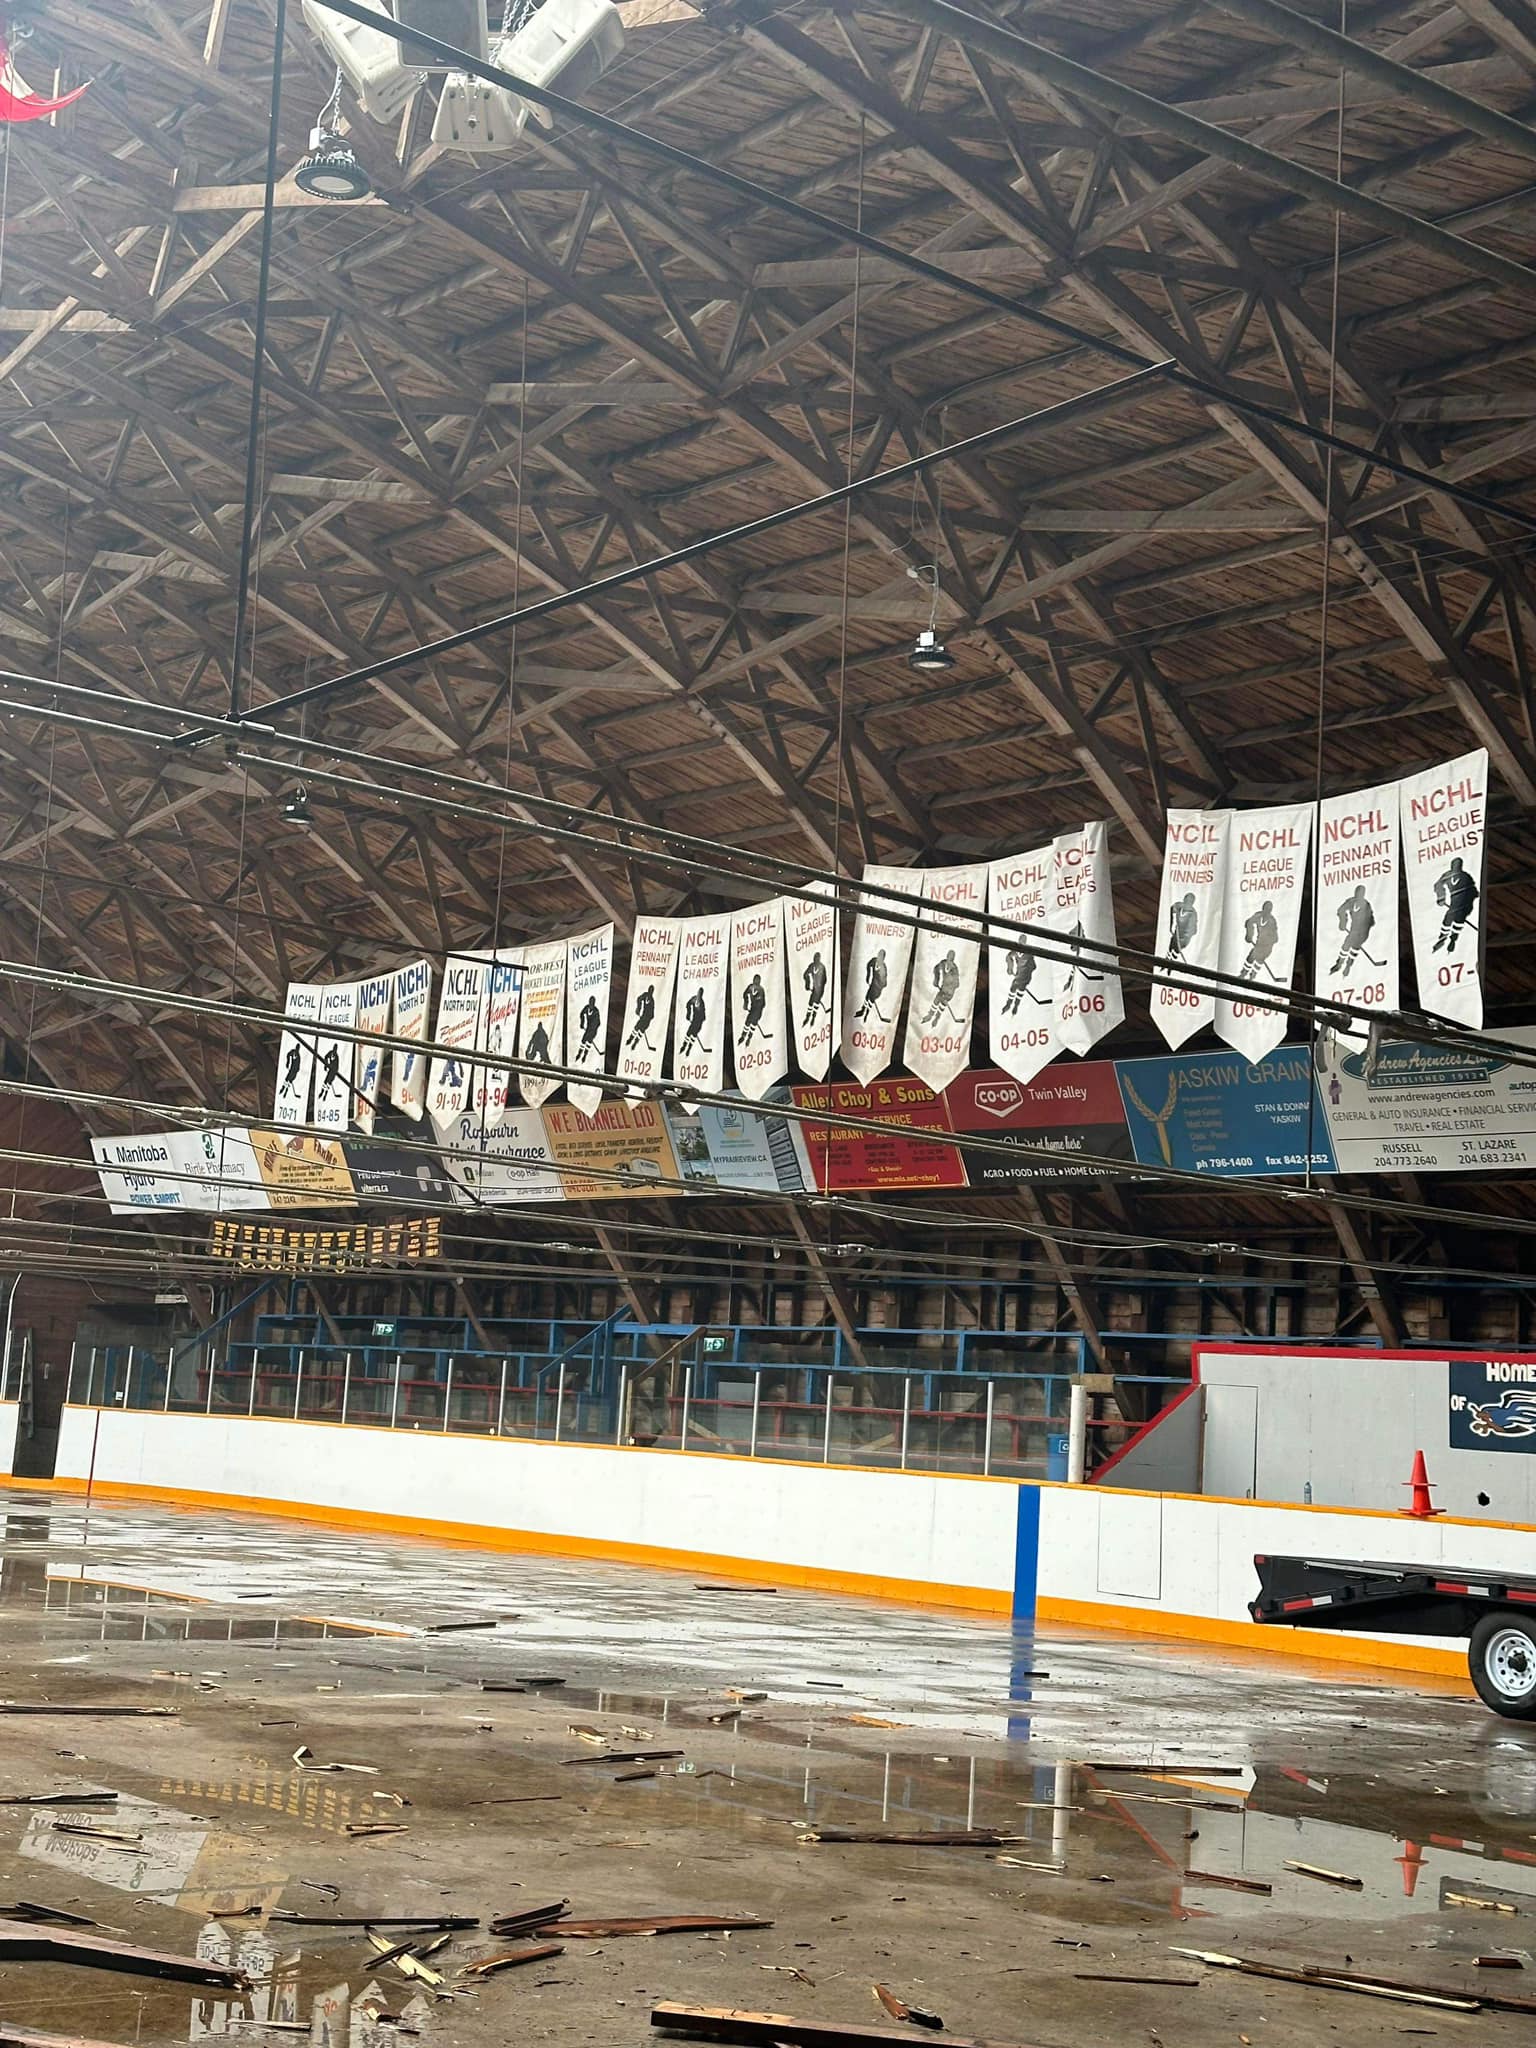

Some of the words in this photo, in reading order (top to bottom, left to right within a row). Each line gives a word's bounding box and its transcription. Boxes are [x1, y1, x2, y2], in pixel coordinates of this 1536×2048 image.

[1410, 778, 1484, 821] NCHL
[1324, 808, 1389, 844] NCHL
[1419, 809, 1482, 843] LEAGUE
[1240, 828, 1301, 852] NCHL
[1323, 839, 1392, 868] PENNANT
[1243, 858, 1294, 875] LEAGUE
[1323, 860, 1392, 887] WINNERS
[997, 863, 1047, 892] NCHL
[1240, 876, 1294, 892] CHAMPS
[930, 882, 978, 901] NCHL
[1000, 890, 1042, 912] LEAGUE
[736, 914, 776, 938] NCHL
[796, 912, 831, 937] LEAGUE
[866, 922, 905, 938] WINNERS
[639, 928, 674, 946] NCHL
[686, 929, 722, 948] NCHL
[795, 926, 833, 952] CHAMPS
[572, 938, 608, 961] NCHL
[736, 937, 776, 958] PENNANT
[636, 950, 672, 964] PENNANT
[685, 952, 719, 966] LEAGUE
[737, 952, 775, 971] WINNERS
[528, 959, 564, 976] OR-WEST
[574, 959, 608, 978] LEAGUE
[638, 965, 667, 977] WINNER
[683, 966, 720, 980] CHAMPS
[447, 969, 478, 996] NCHL
[483, 966, 521, 994] NCHL
[573, 972, 609, 992] CHAMPS
[290, 994, 316, 1009] NCHL
[325, 994, 352, 1009] NCHL
[443, 999, 466, 1011] NORTH
[1160, 987, 1200, 1008] 05-06
[803, 1023, 832, 1052] 02-03
[852, 1030, 886, 1051] 03-04
[921, 1036, 962, 1054] 03-04
[1001, 1028, 1049, 1052] 04-05
[624, 1058, 652, 1076] 01-02
[739, 1049, 772, 1071] 02-03
[680, 1064, 709, 1080] 01-02
[436, 1092, 462, 1111] 91-92
[801, 1092, 835, 1109] Allen
[838, 1089, 873, 1108] Choy
[879, 1087, 892, 1104] &
[896, 1086, 936, 1103] Sons
[1028, 1088, 1053, 1101] Twin
[1054, 1085, 1087, 1101] Valley
[1368, 1089, 1496, 1104] www.andrewagencies.com
[279, 1106, 297, 1121] 70-71
[317, 1109, 341, 1122] 84-85
[1255, 1104, 1275, 1113] STAN
[1276, 1103, 1282, 1111] &
[1332, 1112, 1368, 1121] GENERAL
[1370, 1110, 1377, 1119] &
[1379, 1109, 1401, 1119] AUTO
[1402, 1106, 1451, 1118] INSURANCE
[1458, 1103, 1506, 1116] FINANCIAL
[1270, 1115, 1301, 1124] YASKIW
[1393, 1122, 1424, 1132] TRAVEL
[1431, 1120, 1453, 1131] REAL
[1455, 1119, 1486, 1130] ESTATE
[809, 1129, 865, 1143] RESAURANT
[116, 1144, 168, 1163] Manitoba
[1382, 1143, 1422, 1154] RUSSELL
[1462, 1141, 1476, 1151] ST.
[1478, 1139, 1517, 1150] LAZARE
[1196, 1160, 1208, 1170] ph
[1211, 1157, 1253, 1167] 796-1400
[1265, 1156, 1282, 1165] fax
[1374, 1156, 1438, 1167] 204.773.2640
[1458, 1152, 1527, 1164] 204.683.2341
[206, 1162, 245, 1176] Phrmacy
[983, 1169, 1004, 1178] AGRO
[1011, 1168, 1033, 1177] FOOD
[1039, 1168, 1058, 1177] FUEL
[1065, 1167, 1088, 1176] HOME
[155, 1192, 181, 1204] SMART
[1486, 1362, 1536, 1382] HOME
[1450, 1394, 1467, 1411] OF
